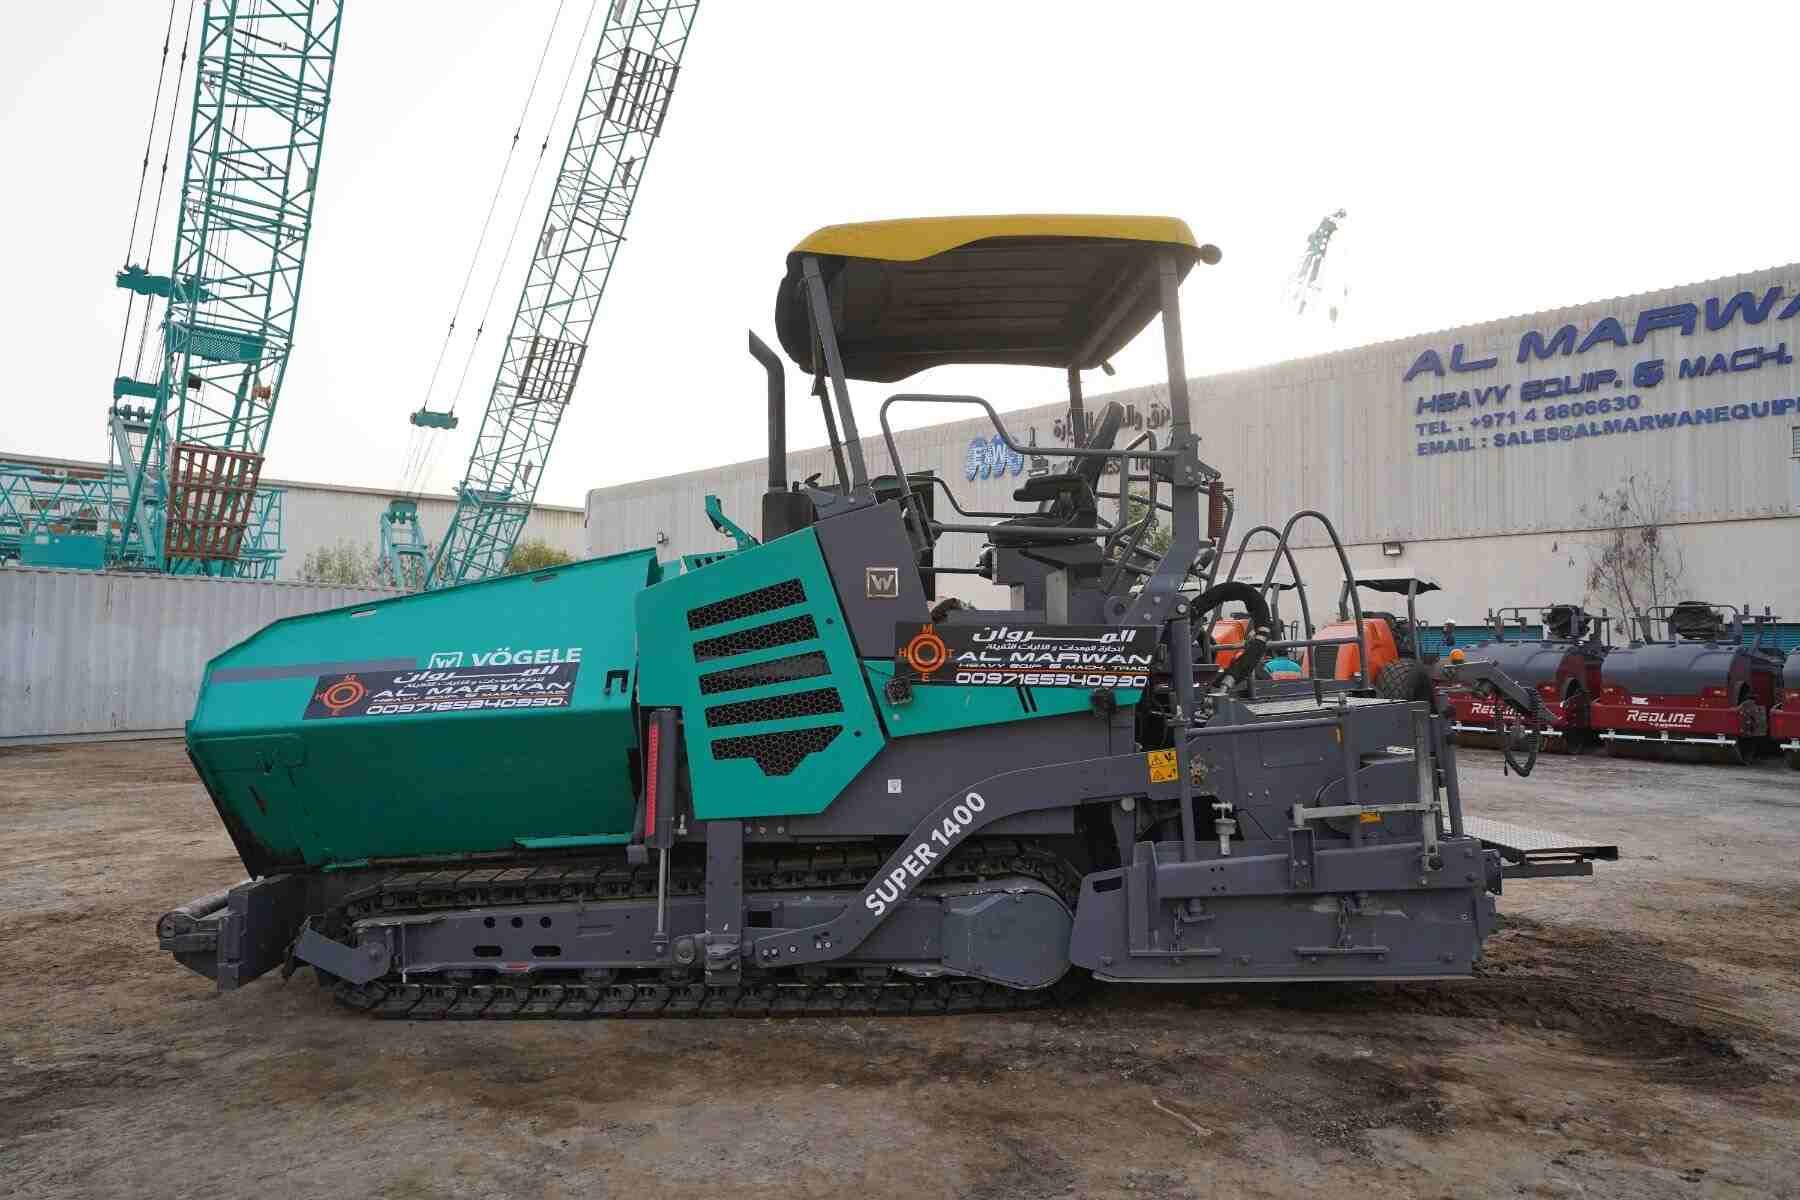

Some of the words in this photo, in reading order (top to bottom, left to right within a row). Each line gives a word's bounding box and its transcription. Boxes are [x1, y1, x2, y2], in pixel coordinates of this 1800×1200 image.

[1402, 343, 1498, 382] AL
[1415, 384, 1511, 416] HEAVY
[1633, 358, 1665, 388] &
[1679, 342, 1793, 380] MACH.
[1416, 437, 1475, 457] EMAIL
[1493, 396, 1800, 448] SALES@ALMARWANEQUIP
[1470, 410, 1516, 430] +971
[1525, 408, 1537, 422] 4
[471, 647, 583, 668] VÖGELE
[956, 652, 1002, 662] AL
[1010, 652, 1153, 665] MARWAN
[371, 689, 419, 699] AL
[426, 682, 572, 695] MARWAN
[955, 672, 1148, 688] 0097165340990
[1626, 709, 1696, 723] REDLINE
[865, 843, 939, 916] SUPER
[932, 792, 985, 846] 1400
